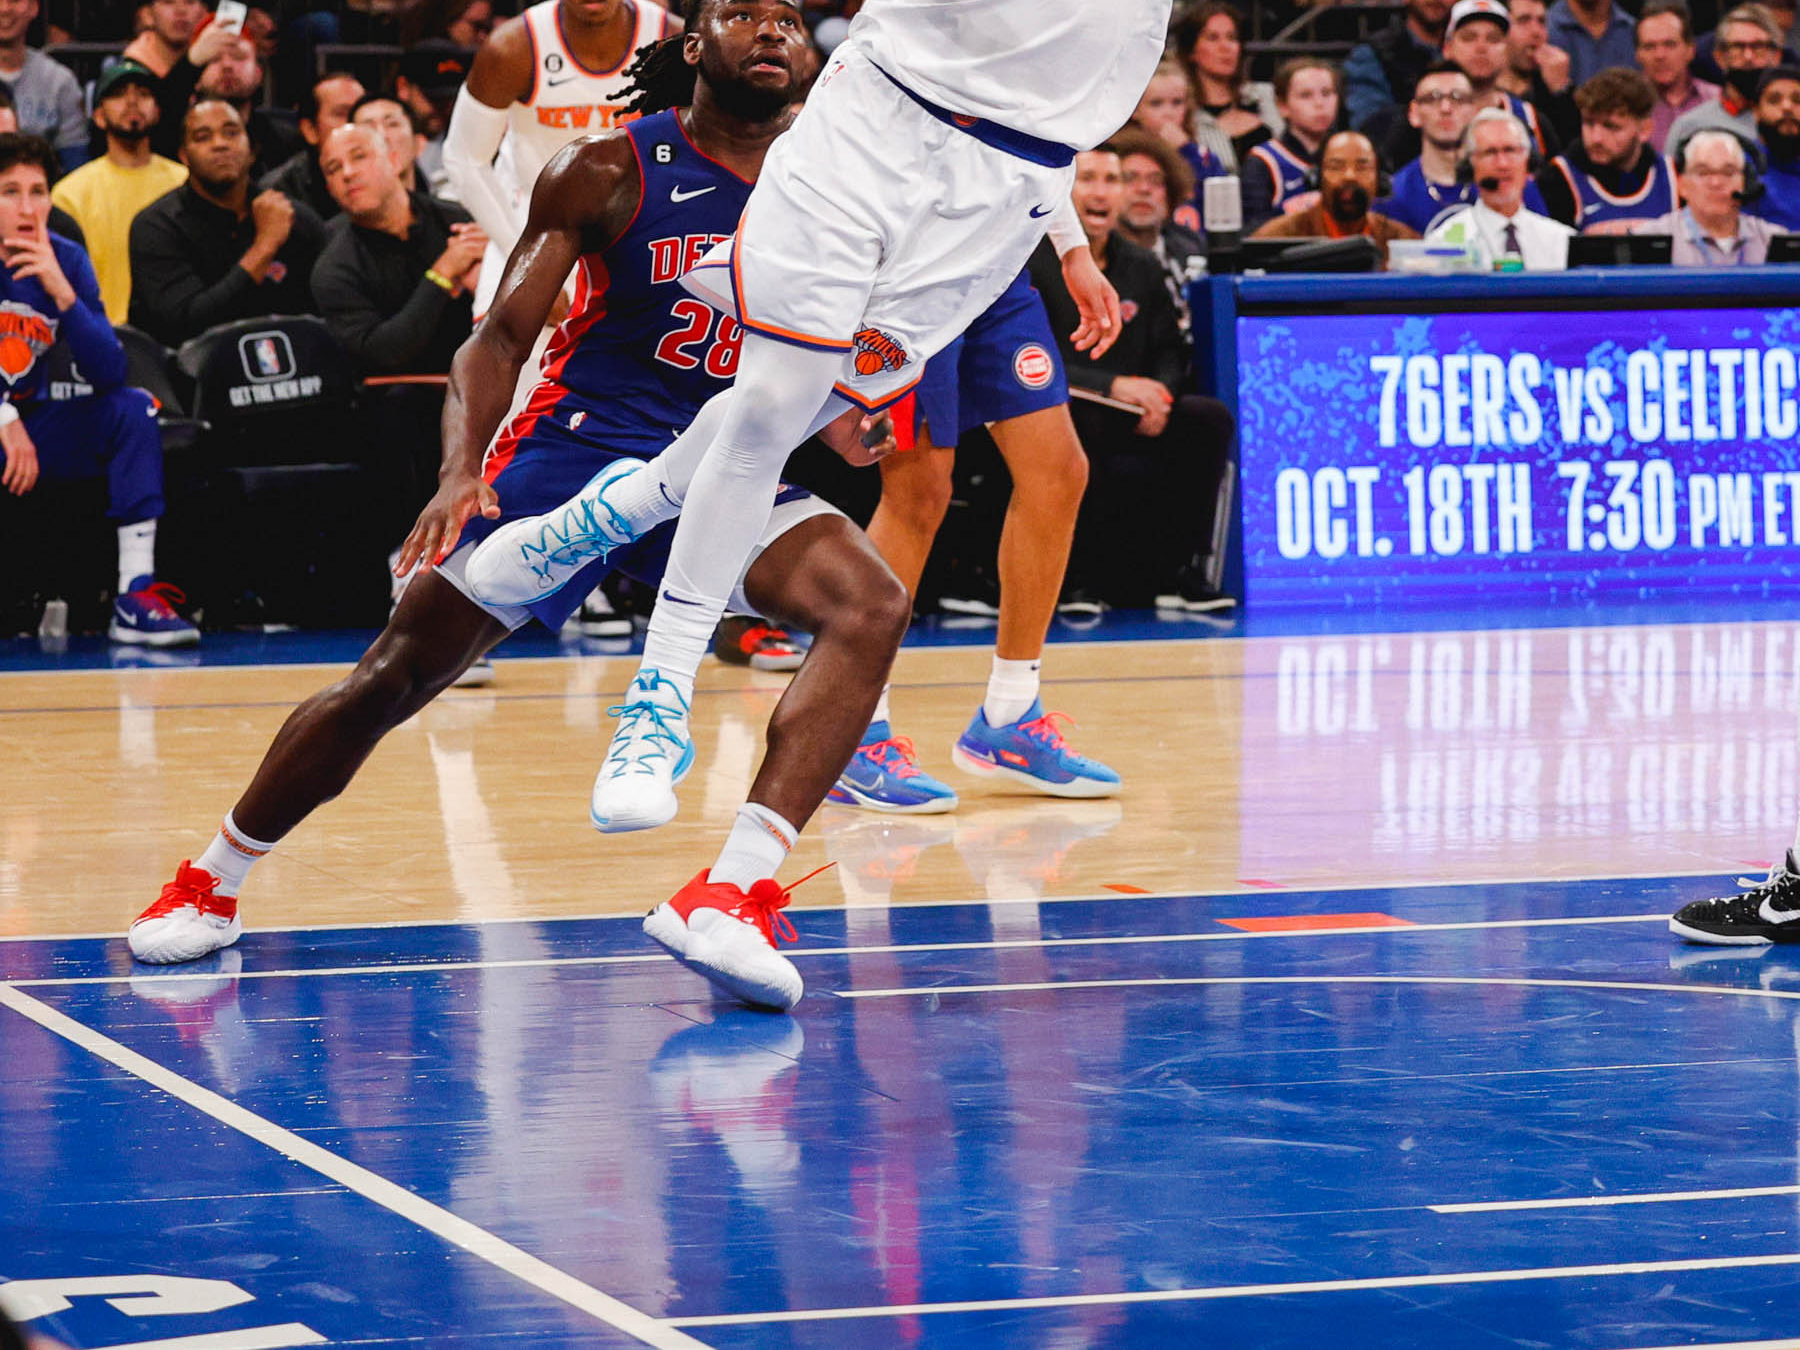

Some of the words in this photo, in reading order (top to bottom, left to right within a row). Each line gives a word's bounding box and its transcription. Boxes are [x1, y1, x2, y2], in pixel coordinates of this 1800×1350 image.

[536, 105, 594, 129] NEW
[655, 144, 672, 163] 6
[648, 233, 735, 285] DE
[654, 298, 746, 379] 28
[853, 327, 907, 371] KNICKS
[1369, 352, 1544, 448] 76ERS
[1626, 347, 1800, 444] CELTIC
[1275, 467, 1394, 559] OCT.
[1403, 462, 1533, 555] 18TH
[1558, 459, 1678, 551] 7:30
[1688, 472, 1754, 548] PM
